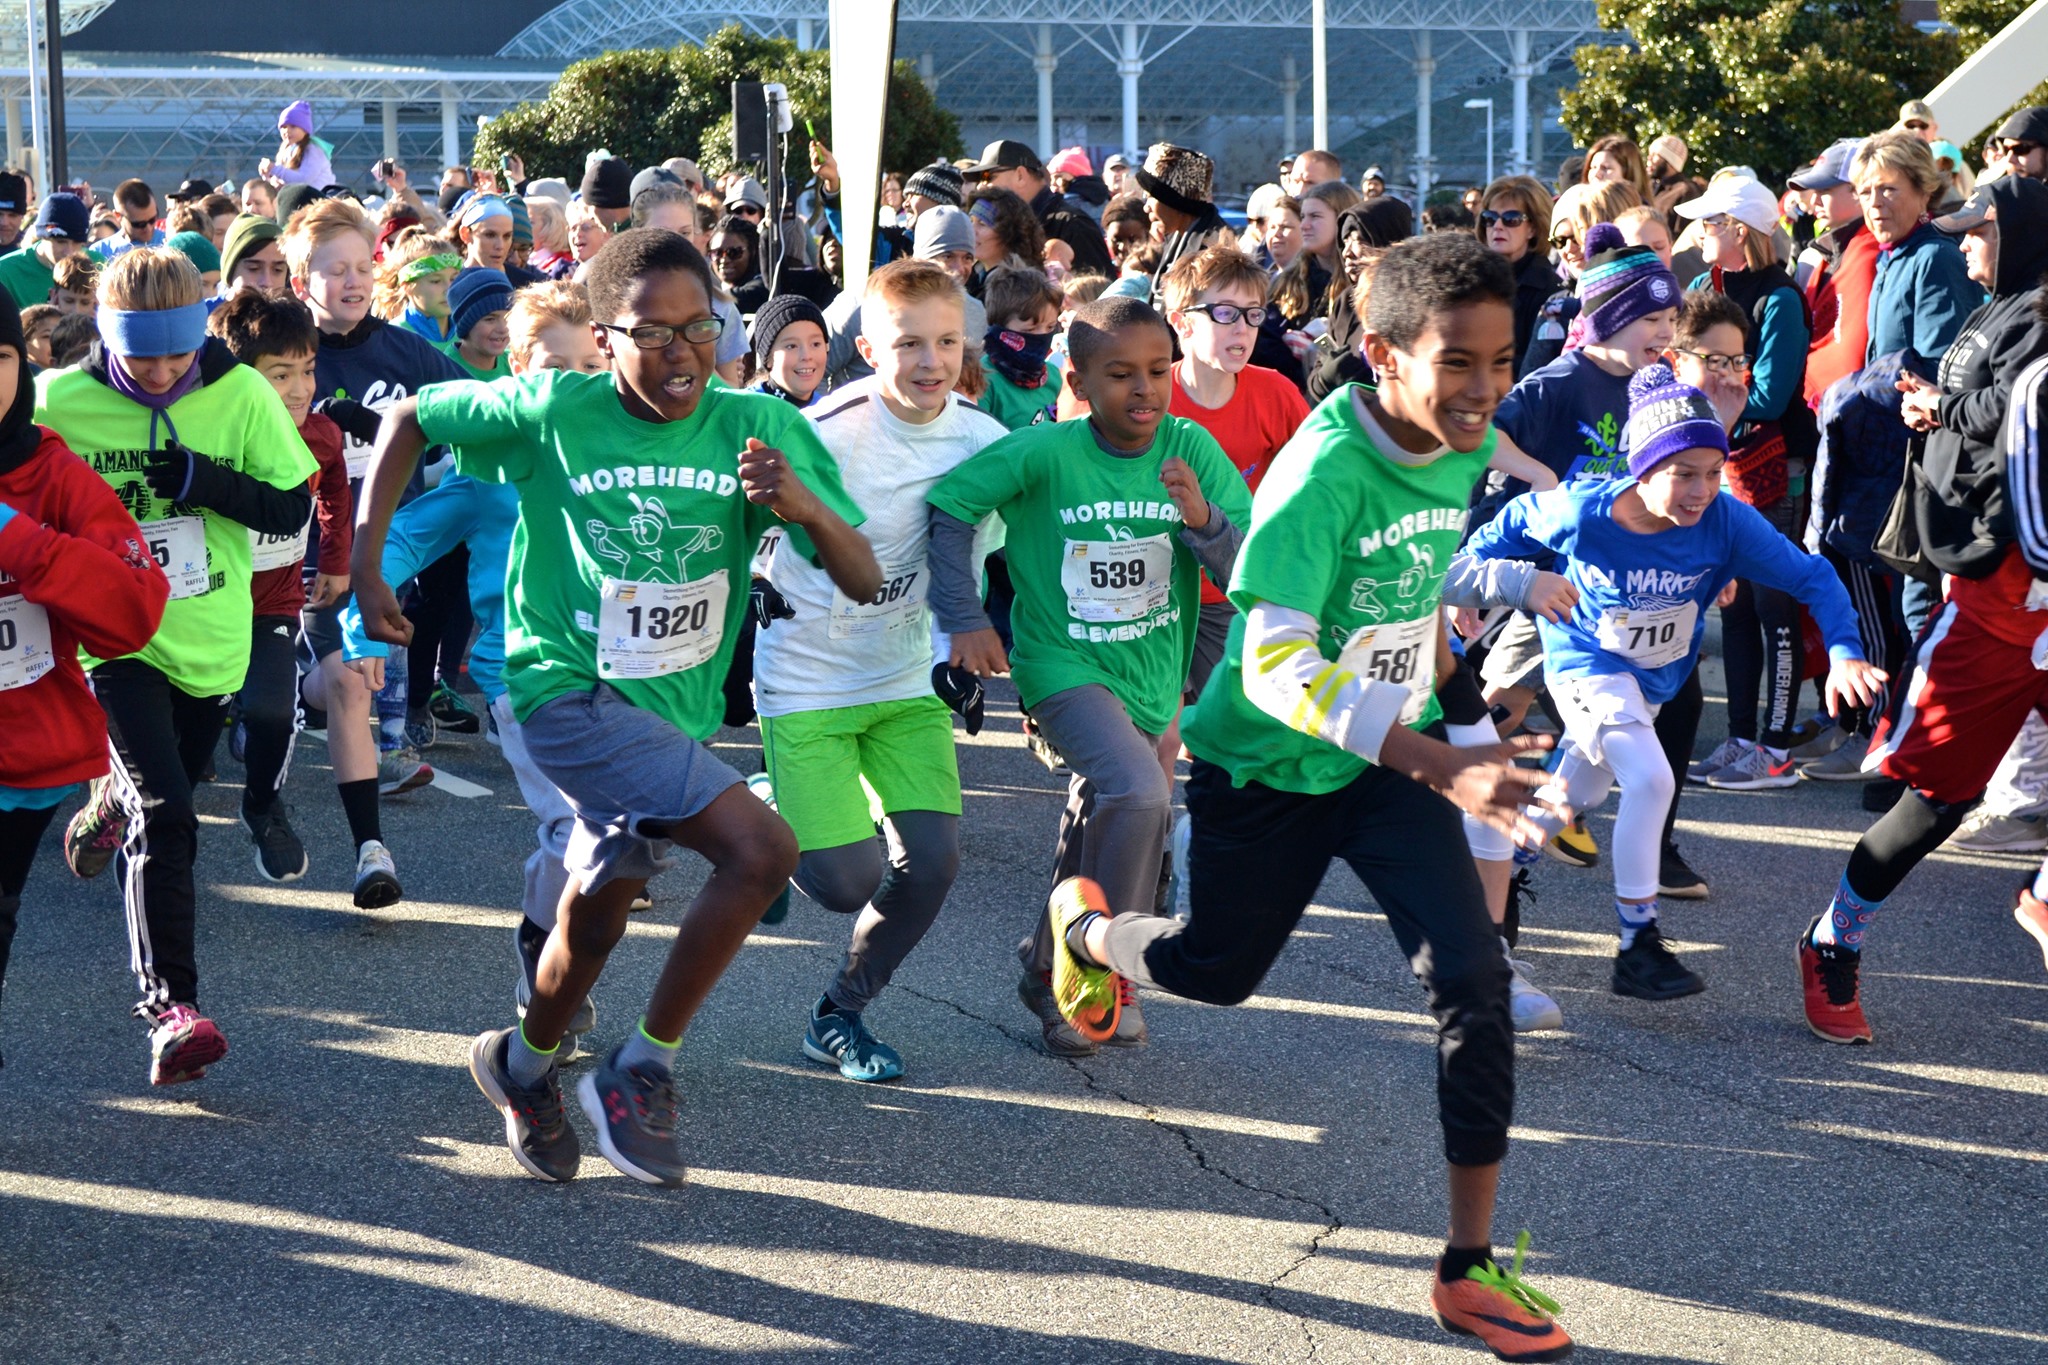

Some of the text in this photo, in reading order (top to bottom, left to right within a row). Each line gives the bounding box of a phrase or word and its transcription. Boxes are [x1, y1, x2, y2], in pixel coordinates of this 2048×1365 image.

[569, 466, 738, 497] MOREHEAD
[858, 572, 918, 606] 567
[1090, 559, 1145, 589] 539
[627, 599, 708, 640] 1320
[1628, 622, 1675, 650] 710
